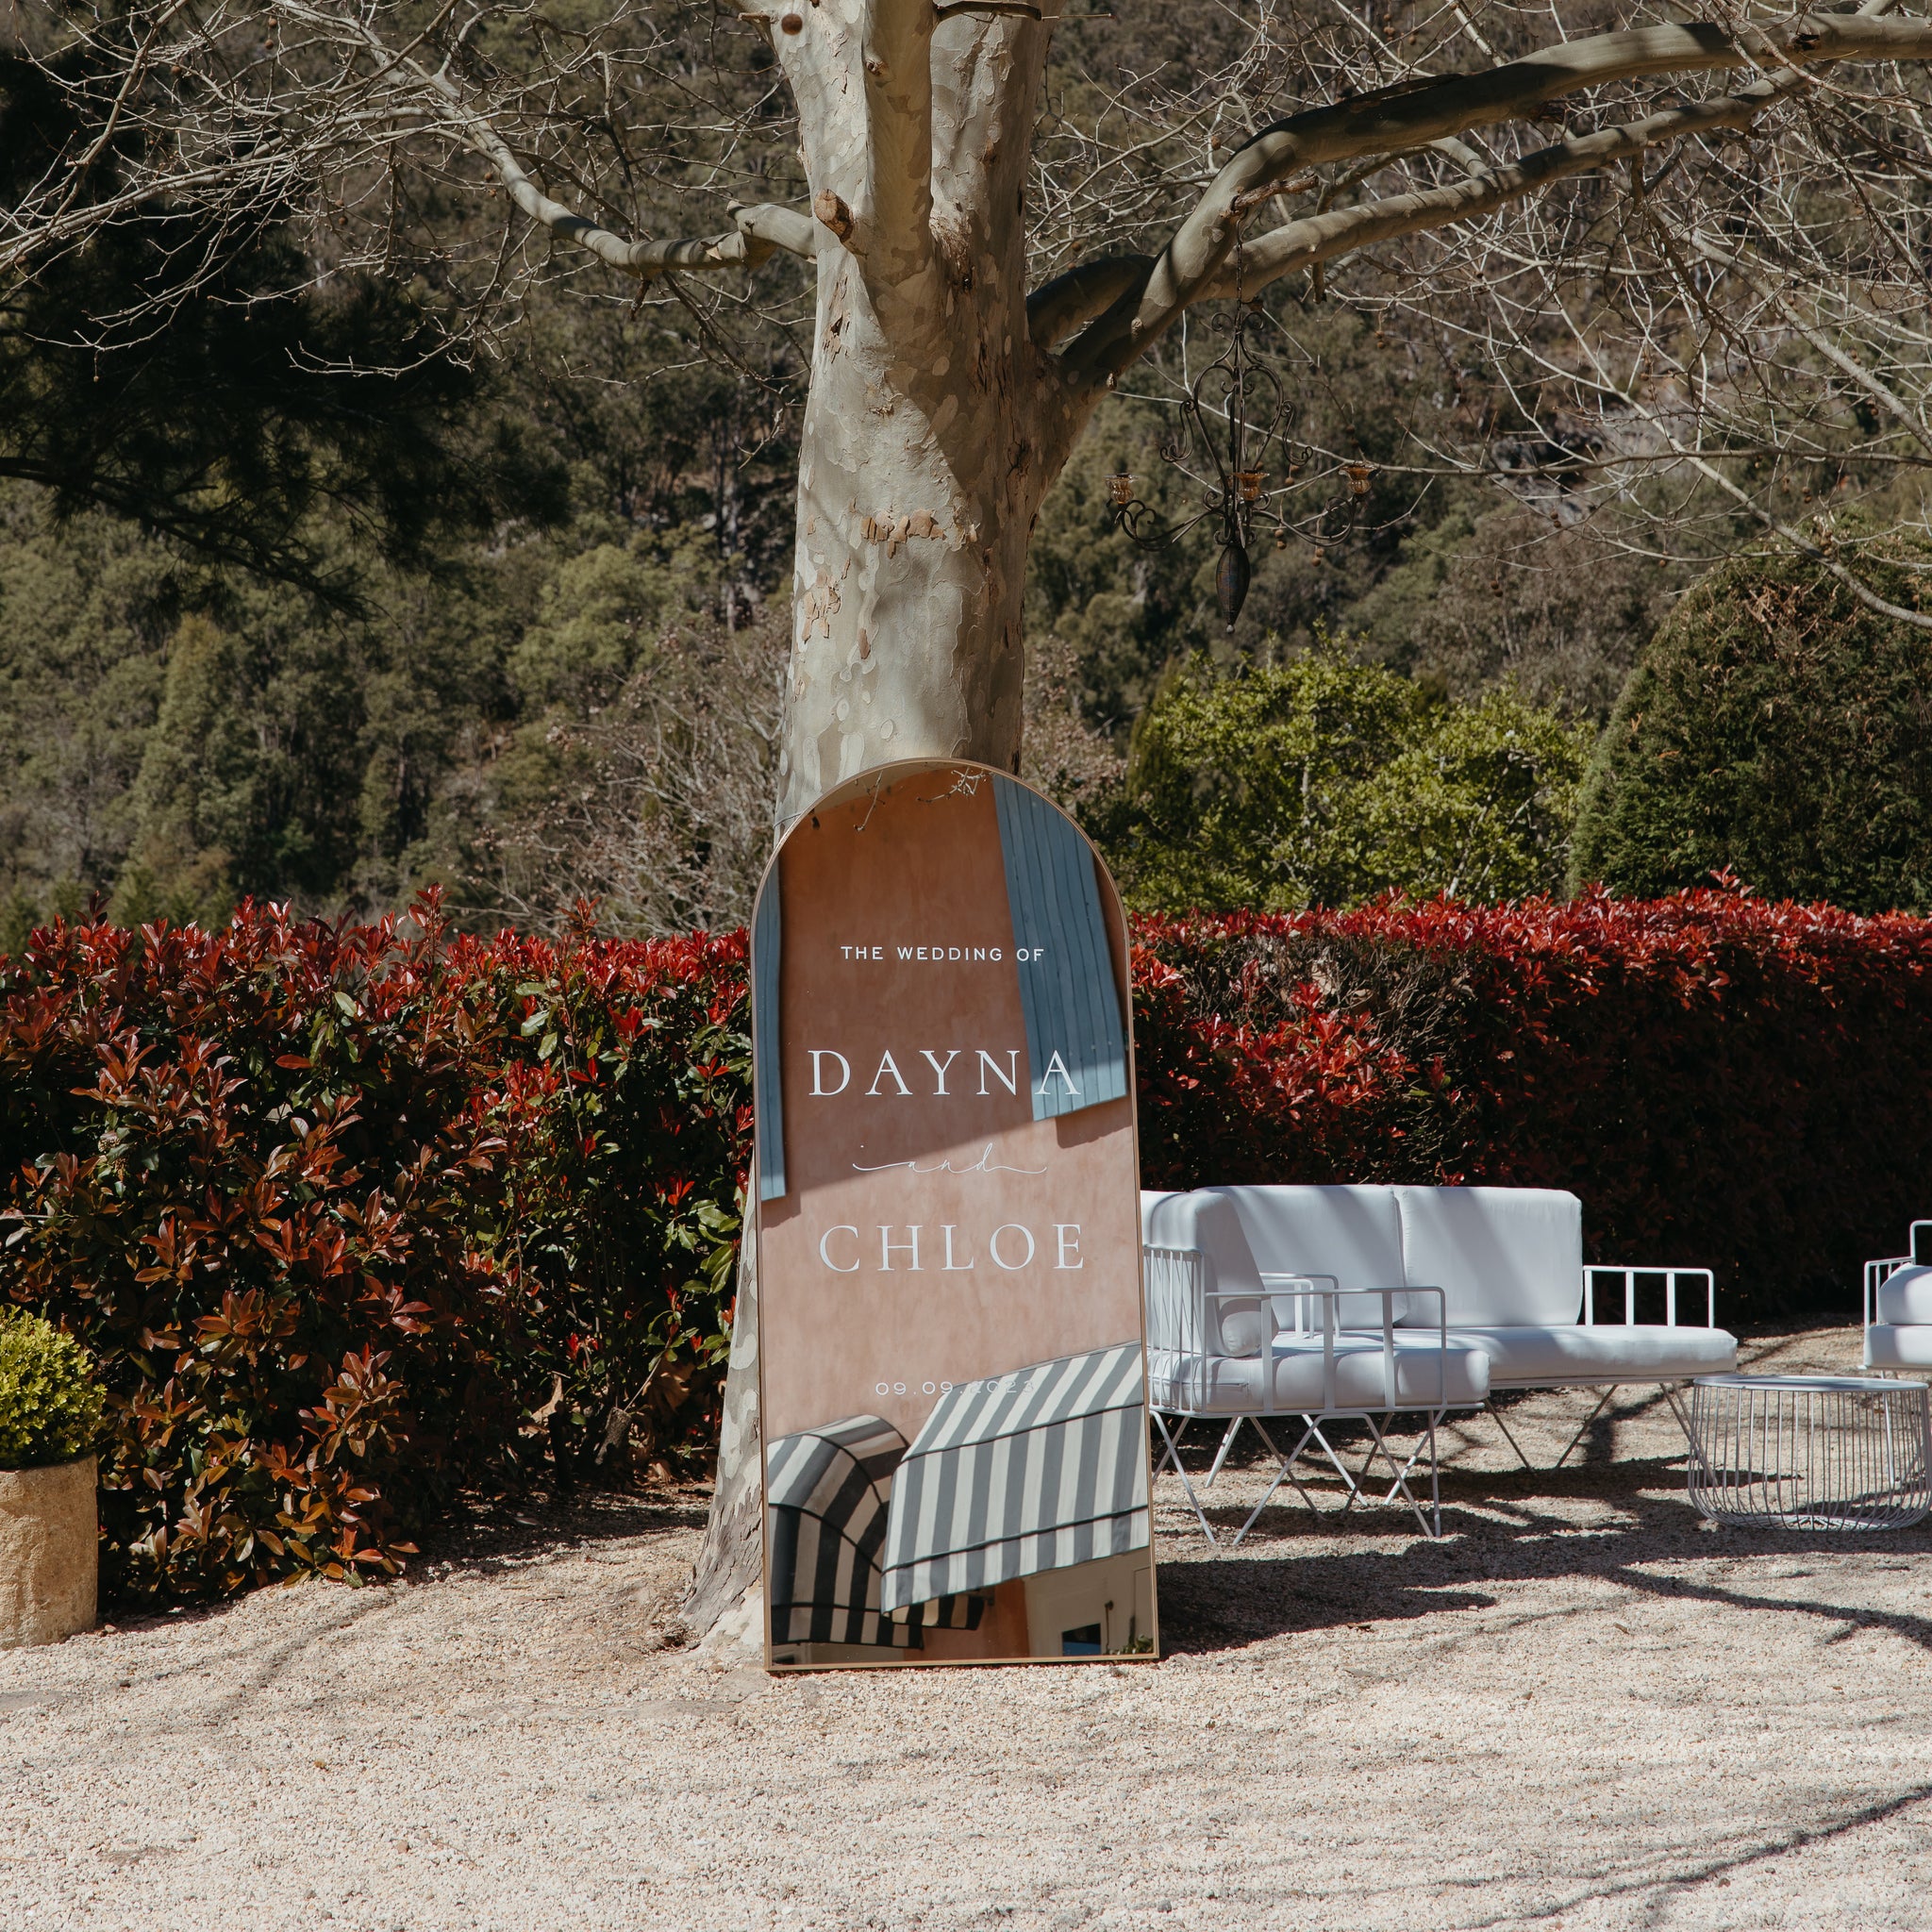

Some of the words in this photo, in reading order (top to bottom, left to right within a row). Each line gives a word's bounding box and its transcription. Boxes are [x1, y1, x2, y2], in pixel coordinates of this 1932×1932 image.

[841, 946, 883, 960] THE
[897, 946, 1003, 961] WEDDING
[1016, 947, 1044, 962] OF
[808, 1049, 1082, 1095] DAYNA
[852, 1142, 1048, 1174] and
[819, 1224, 1084, 1272] CHLOE
